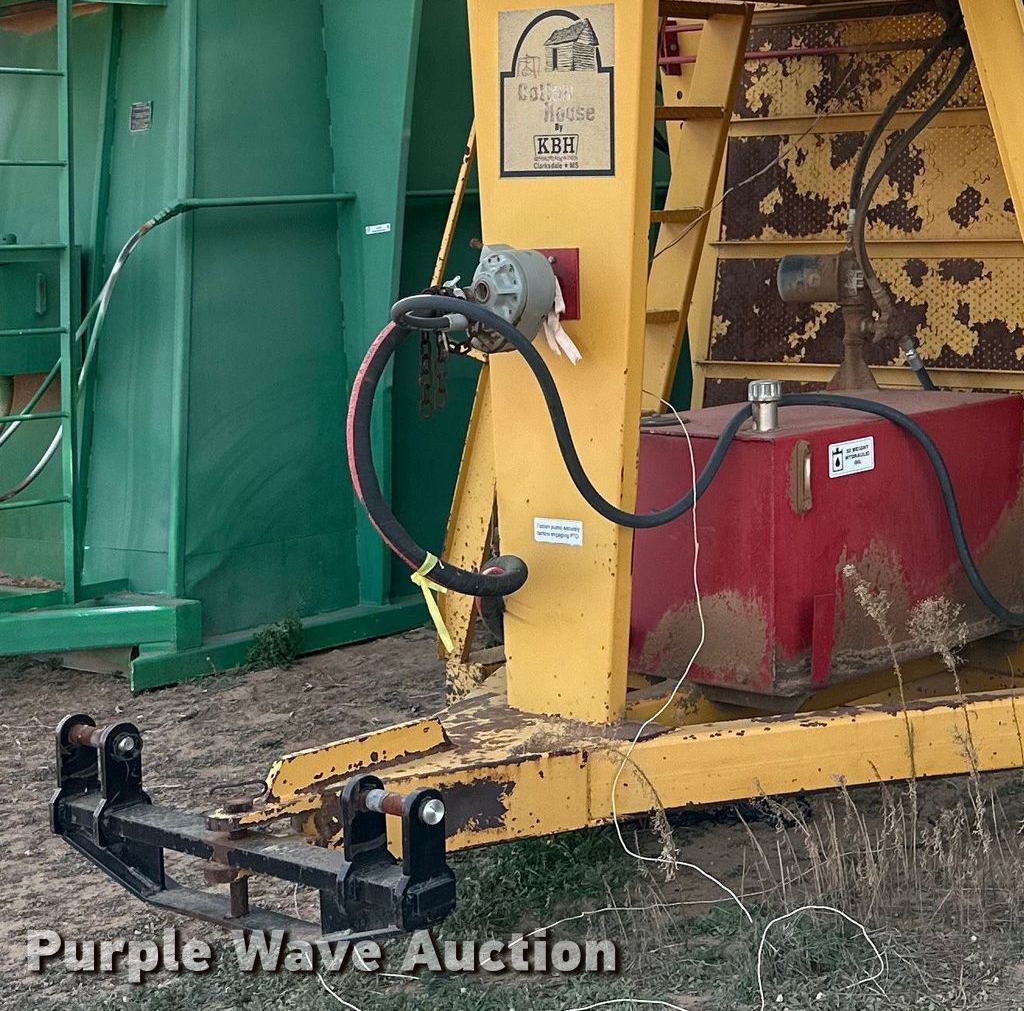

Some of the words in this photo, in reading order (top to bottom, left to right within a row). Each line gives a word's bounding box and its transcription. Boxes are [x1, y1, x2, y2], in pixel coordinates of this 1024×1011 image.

[543, 101, 596, 123] House
[554, 122, 564, 133] By
[536, 136, 576, 155] KBH
[533, 161, 563, 170] Clarksdale
[569, 161, 580, 169] MS
